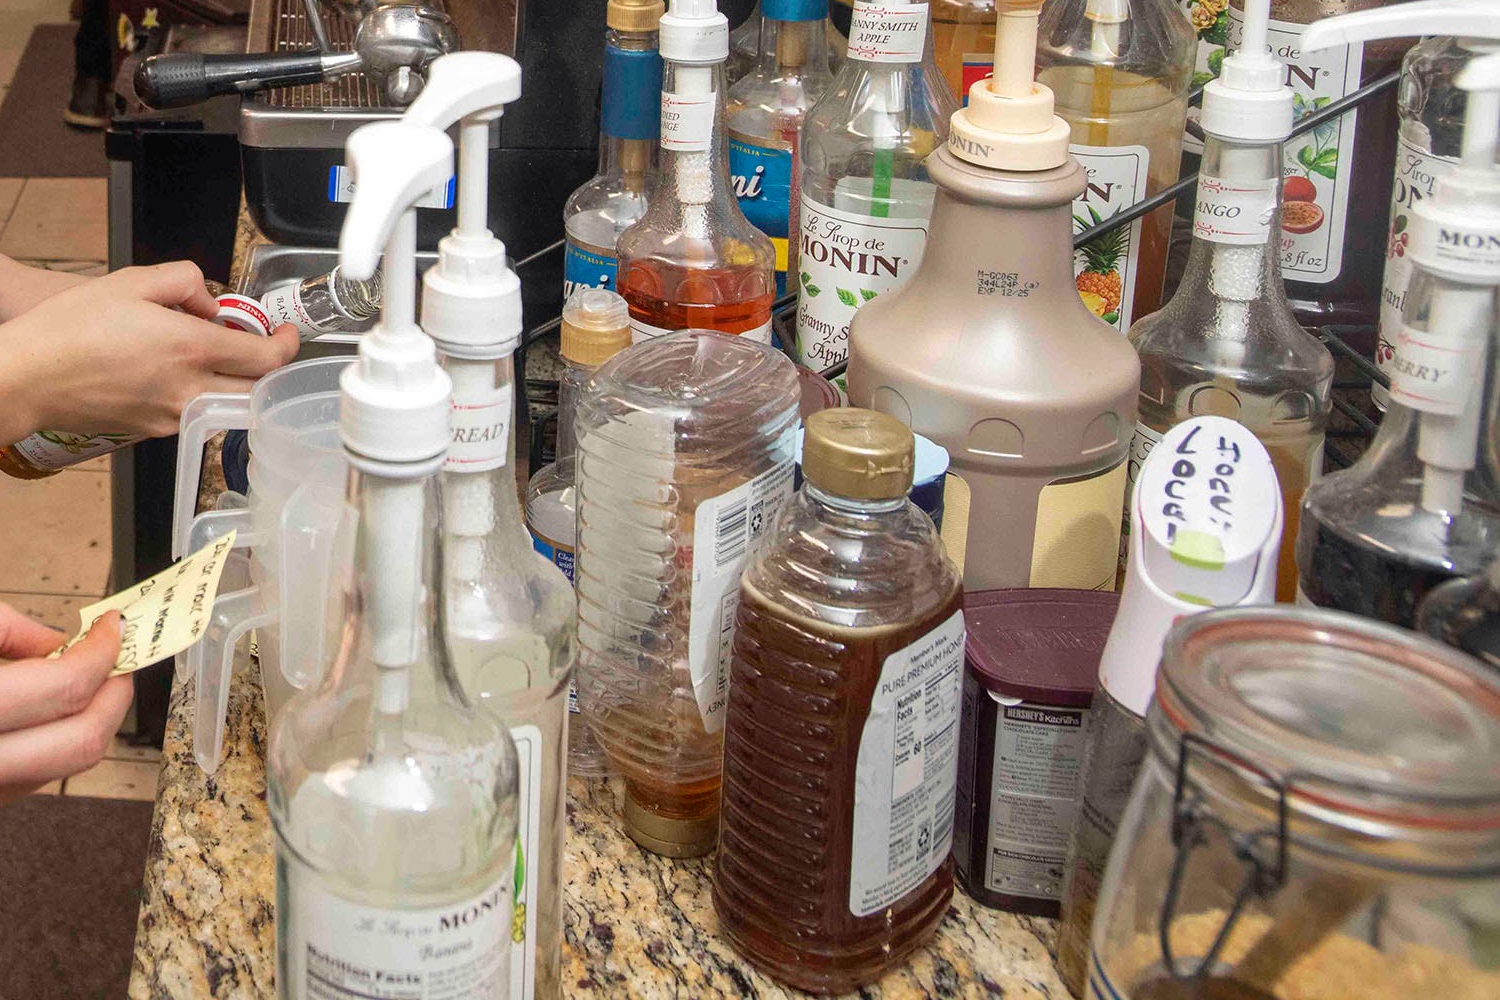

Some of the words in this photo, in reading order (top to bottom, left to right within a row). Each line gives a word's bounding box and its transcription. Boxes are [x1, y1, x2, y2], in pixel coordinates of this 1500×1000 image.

[878, 22, 919, 32] SMITH
[857, 32, 891, 44] APPLE
[1277, 45, 1301, 60] de
[803, 214, 819, 235] Le
[820, 221, 861, 251] Sirop
[864, 237, 885, 251] de
[1289, 250, 1309, 268] fl
[1307, 257, 1322, 267] oz
[977, 286, 996, 296] EXP
[1001, 288, 1029, 297] 12/25
[800, 303, 835, 341] Granny
[881, 678, 906, 696] PURE
[906, 652, 943, 684] PREMIUM
[1007, 707, 1044, 721] HERSHEY'S
